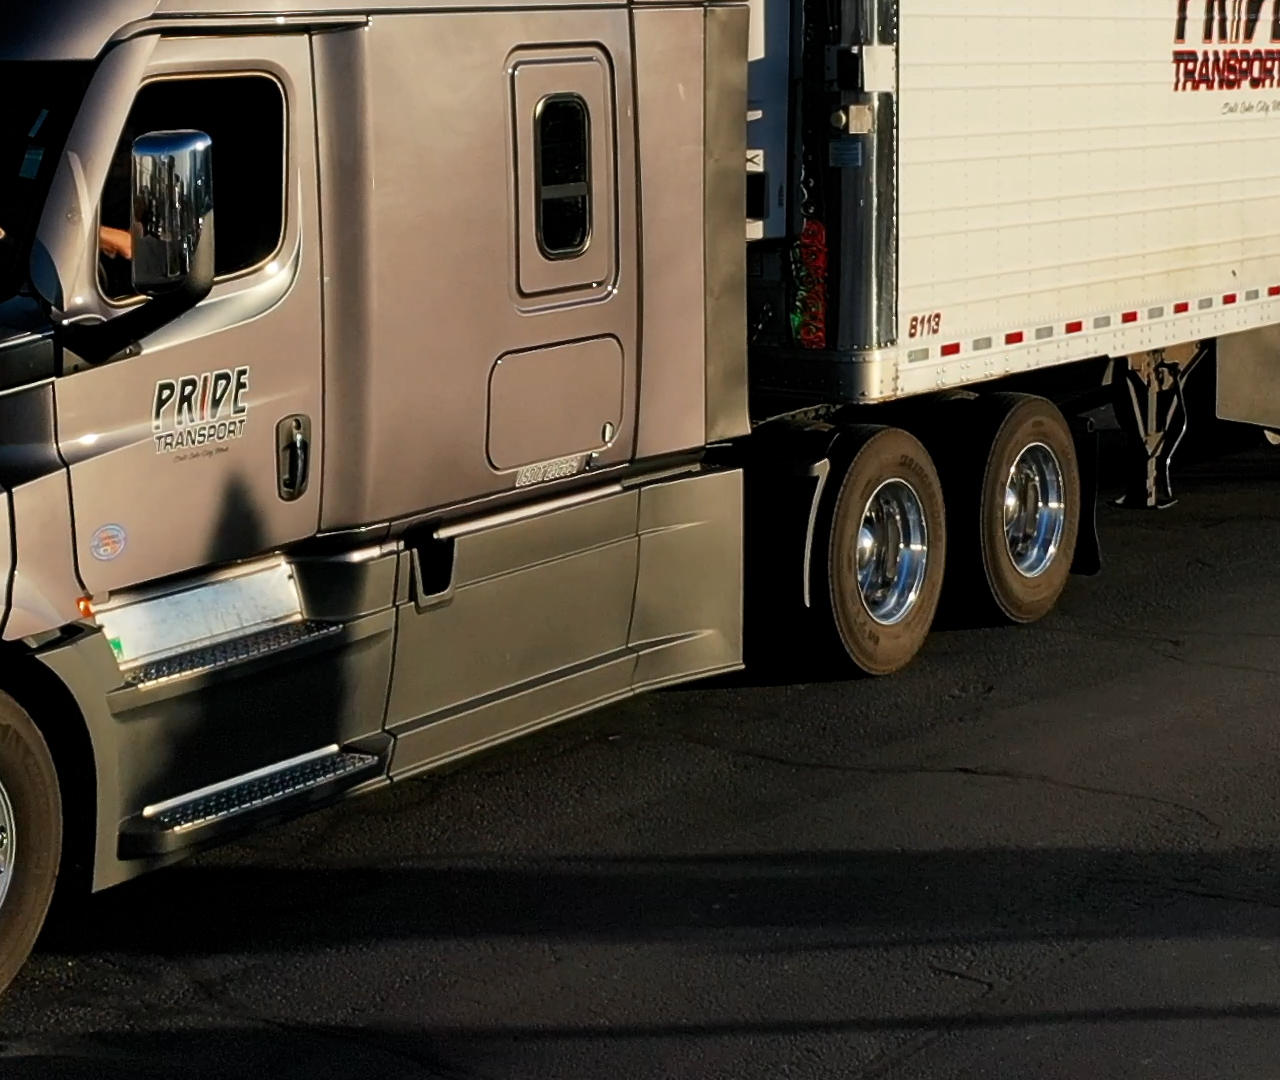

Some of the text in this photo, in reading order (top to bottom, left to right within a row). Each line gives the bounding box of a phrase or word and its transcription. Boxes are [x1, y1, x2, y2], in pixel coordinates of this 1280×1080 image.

[908, 312, 942, 338] 8113
[152, 365, 250, 432] PRIDE
[153, 417, 247, 454] TRANSPORT
